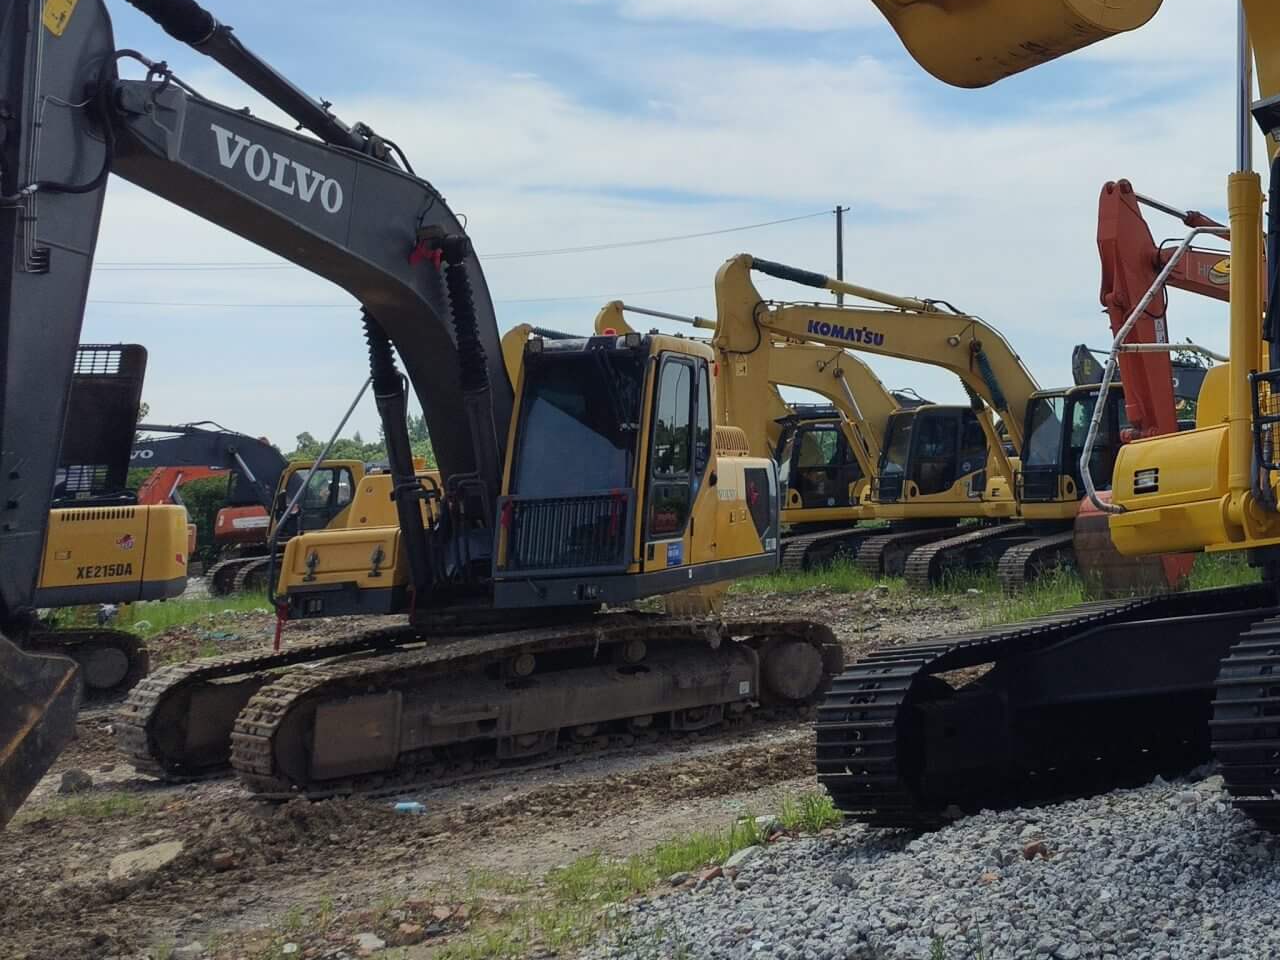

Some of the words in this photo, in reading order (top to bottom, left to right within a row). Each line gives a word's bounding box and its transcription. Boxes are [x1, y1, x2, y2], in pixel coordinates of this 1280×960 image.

[210, 123, 343, 213] VOLVO
[808, 320, 884, 346] KOMATSU
[76, 563, 132, 580] XE215DA
